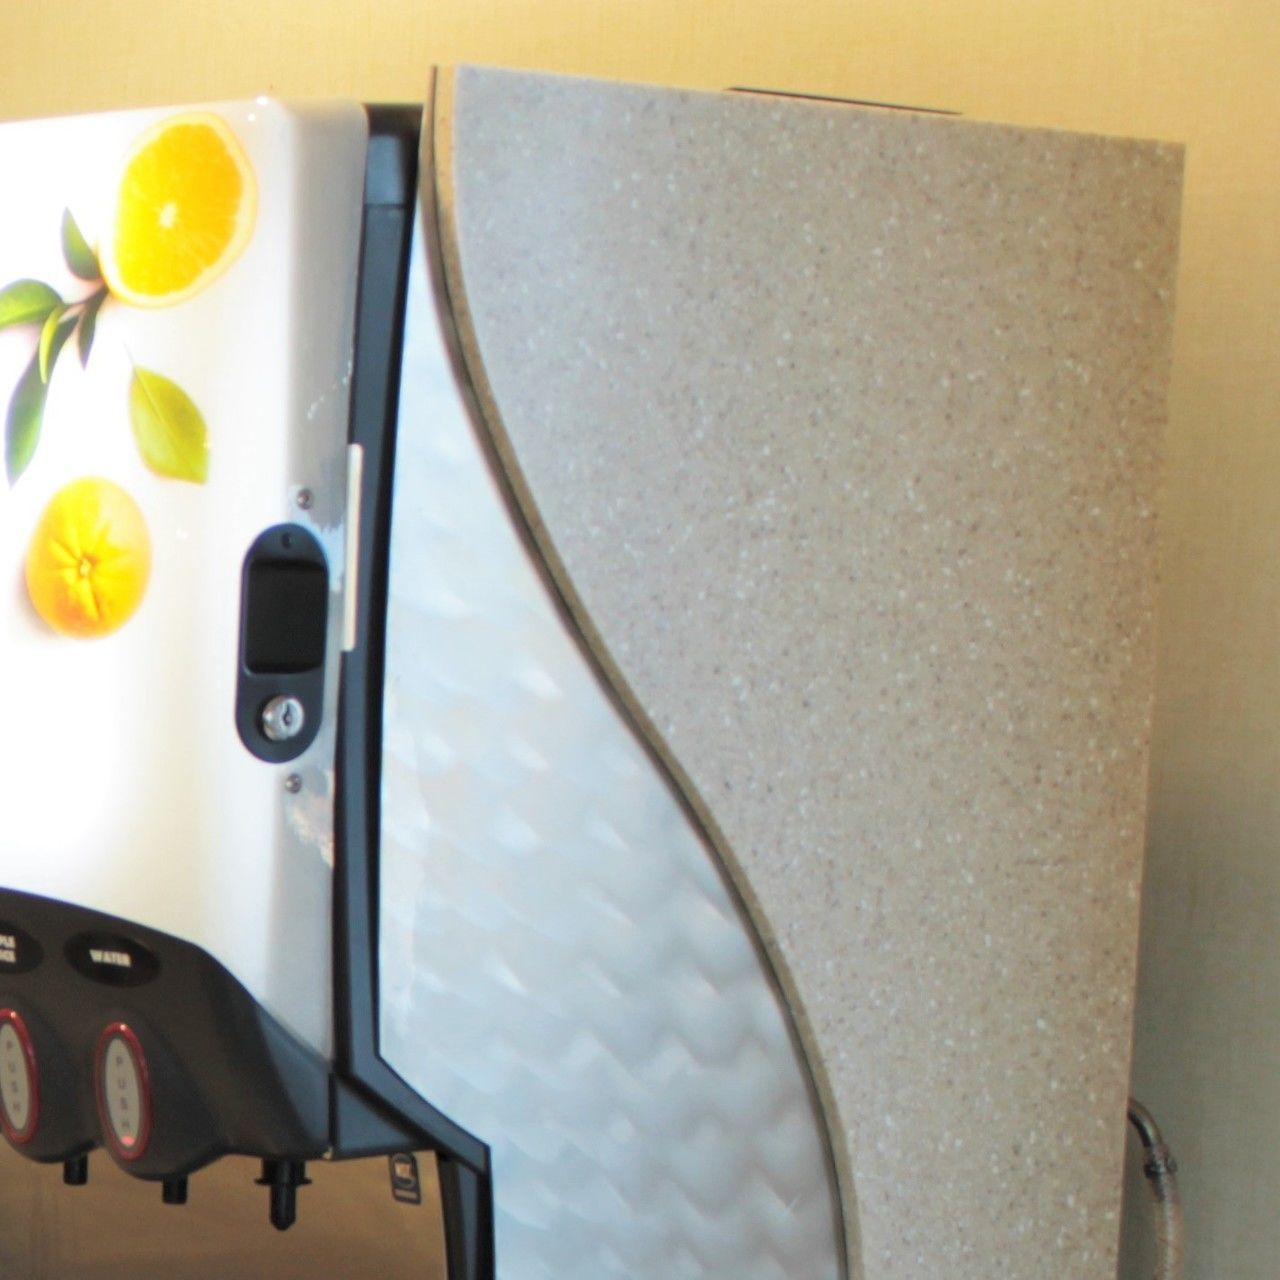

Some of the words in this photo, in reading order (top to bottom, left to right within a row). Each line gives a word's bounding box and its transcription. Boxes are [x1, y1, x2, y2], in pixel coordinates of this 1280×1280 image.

[89, 948, 133, 968] WATER
[5, 1040, 22, 1112] PUSH
[115, 1055, 131, 1129] PUSH
